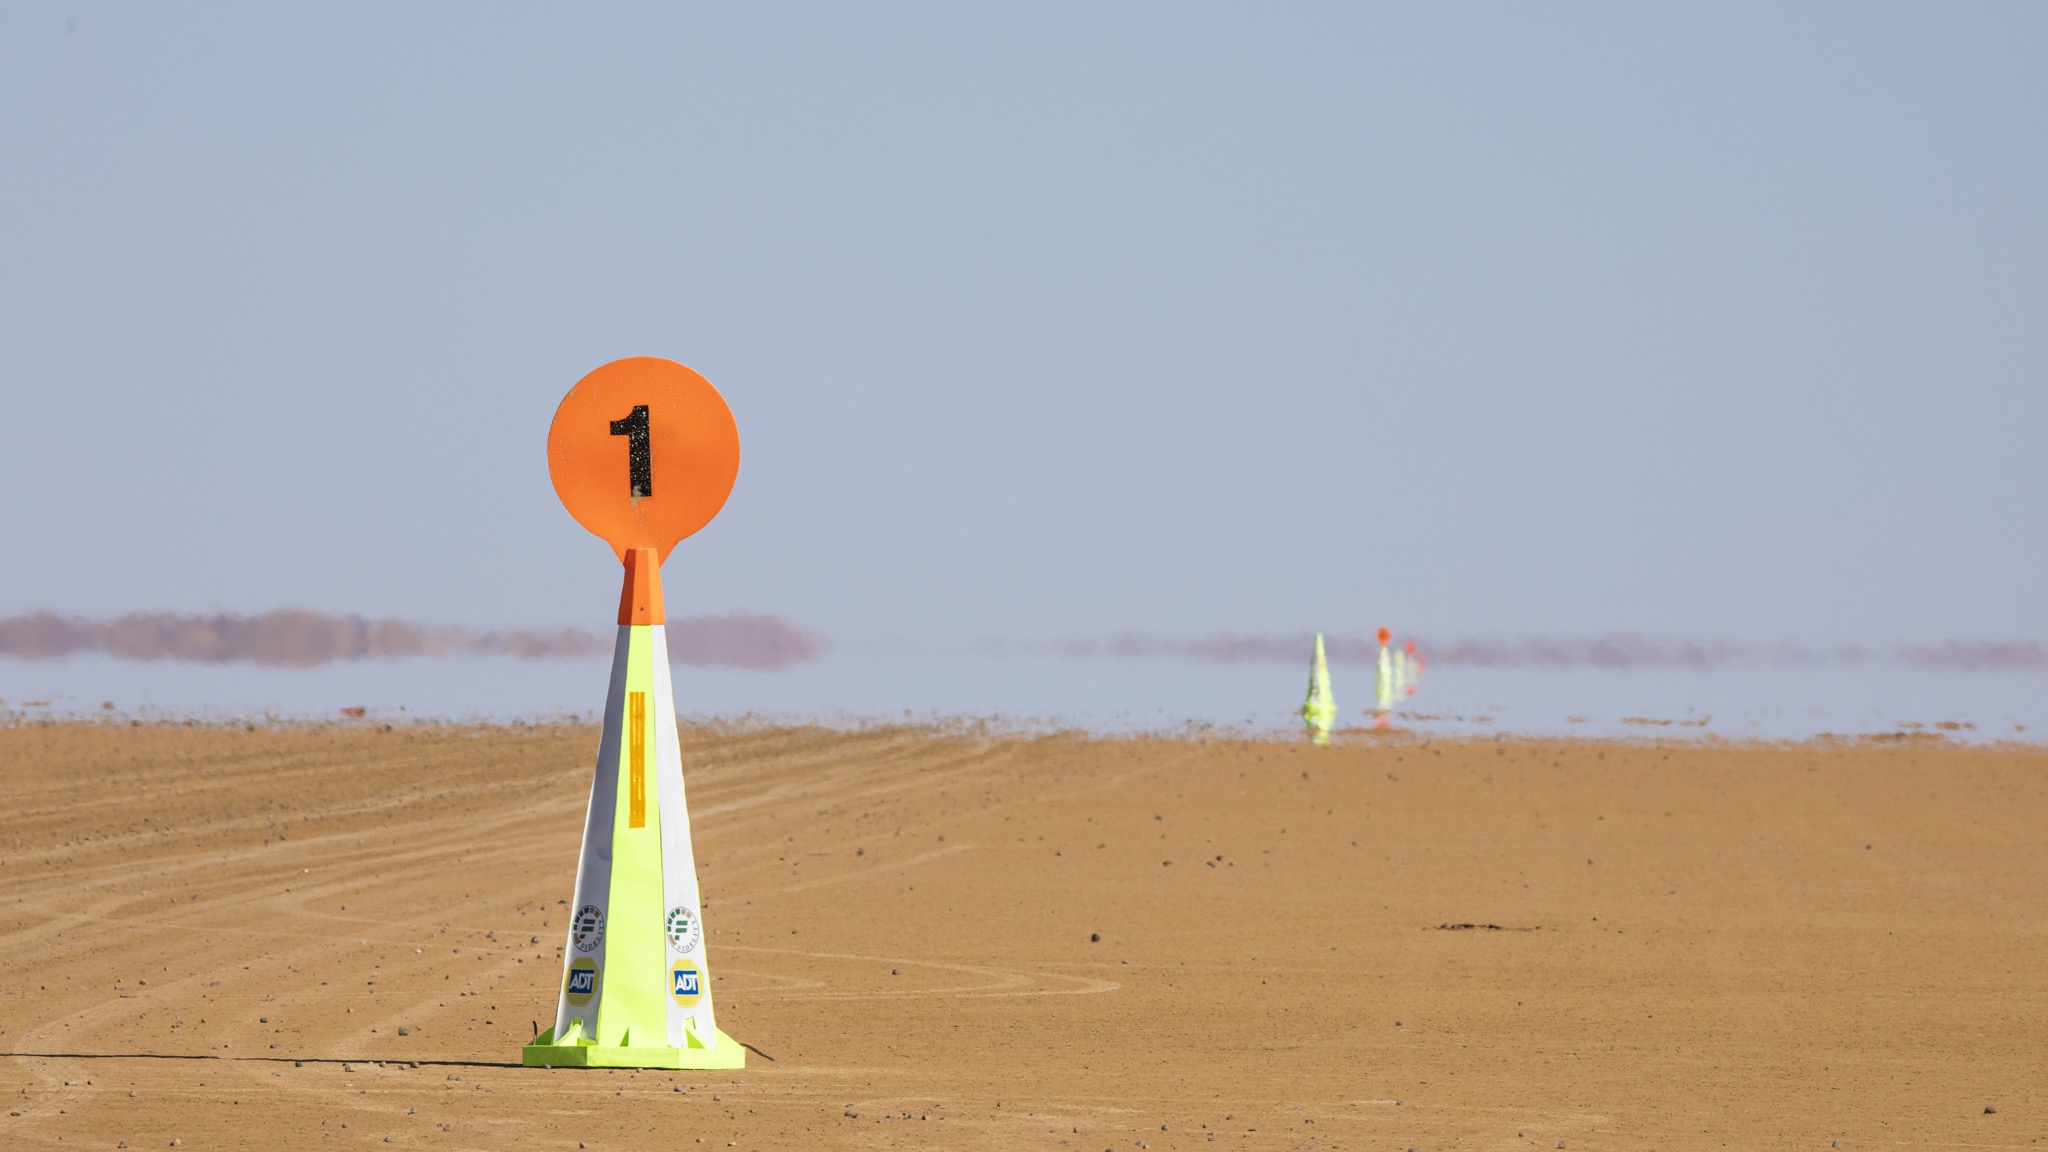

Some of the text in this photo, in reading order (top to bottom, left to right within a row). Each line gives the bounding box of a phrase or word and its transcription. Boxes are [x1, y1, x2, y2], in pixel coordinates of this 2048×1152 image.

[610, 405, 652, 497] 1
[580, 919, 604, 950] FIDELITY
[677, 920, 699, 952] FIDELITY
[569, 973, 594, 990] ADT
[675, 973, 698, 991] ADT
